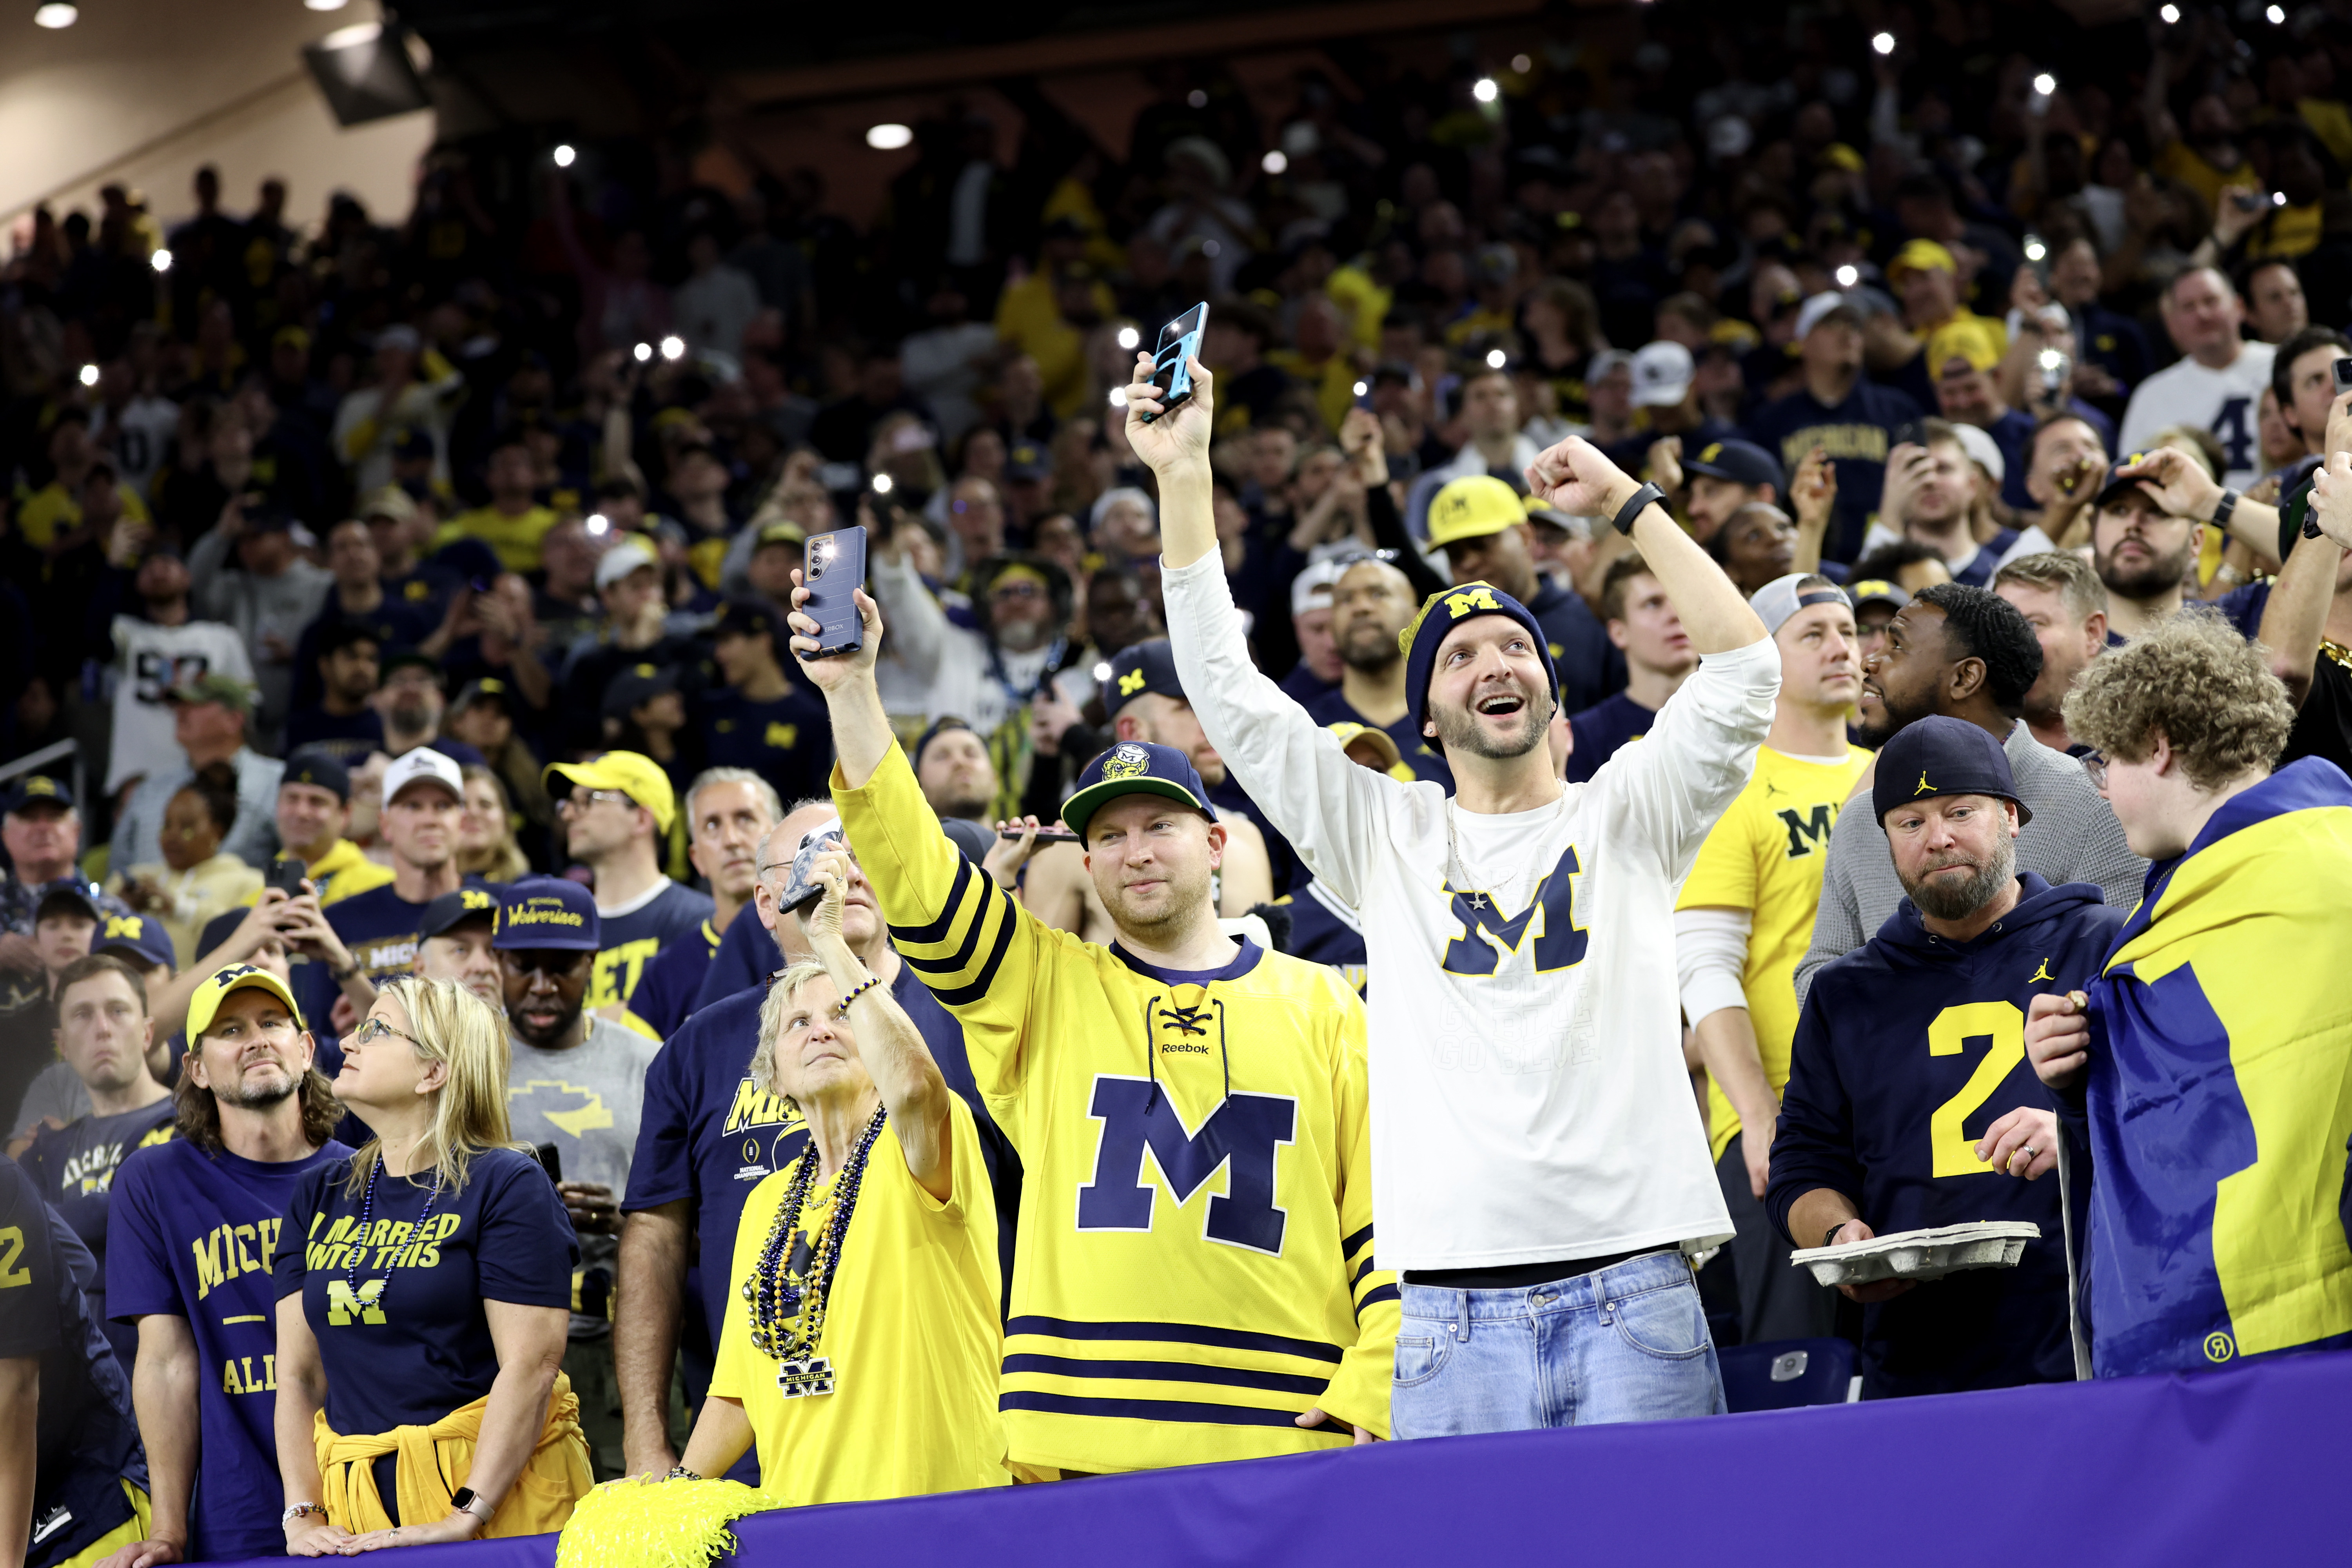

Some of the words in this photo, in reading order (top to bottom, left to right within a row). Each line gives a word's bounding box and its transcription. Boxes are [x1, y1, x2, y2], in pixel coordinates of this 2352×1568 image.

[1444, 588, 1499, 619] M
[1121, 753, 1136, 762] M
[508, 902, 584, 928] Wolverines
[1439, 842, 1590, 978] M
[104, 915, 143, 940] M
[214, 965, 258, 988] M
[582, 936, 660, 1010] ET
[1161, 1043, 1209, 1054] Reebok
[1927, 1000, 2025, 1178] 2
[734, 1169, 771, 1180] CHAMPIONSHIP
[739, 1165, 764, 1173] NATIONAL
[1075, 1073, 1298, 1258] M
[308, 1211, 326, 1240] I
[323, 1213, 461, 1247] MARRIED
[0, 1226, 31, 1289] 2
[192, 1218, 283, 1301] MICH
[305, 1240, 368, 1272] INTO
[371, 1240, 441, 1270] THIS
[327, 1279, 387, 1326] M
[786, 1373, 825, 1383] MICHIGAN
